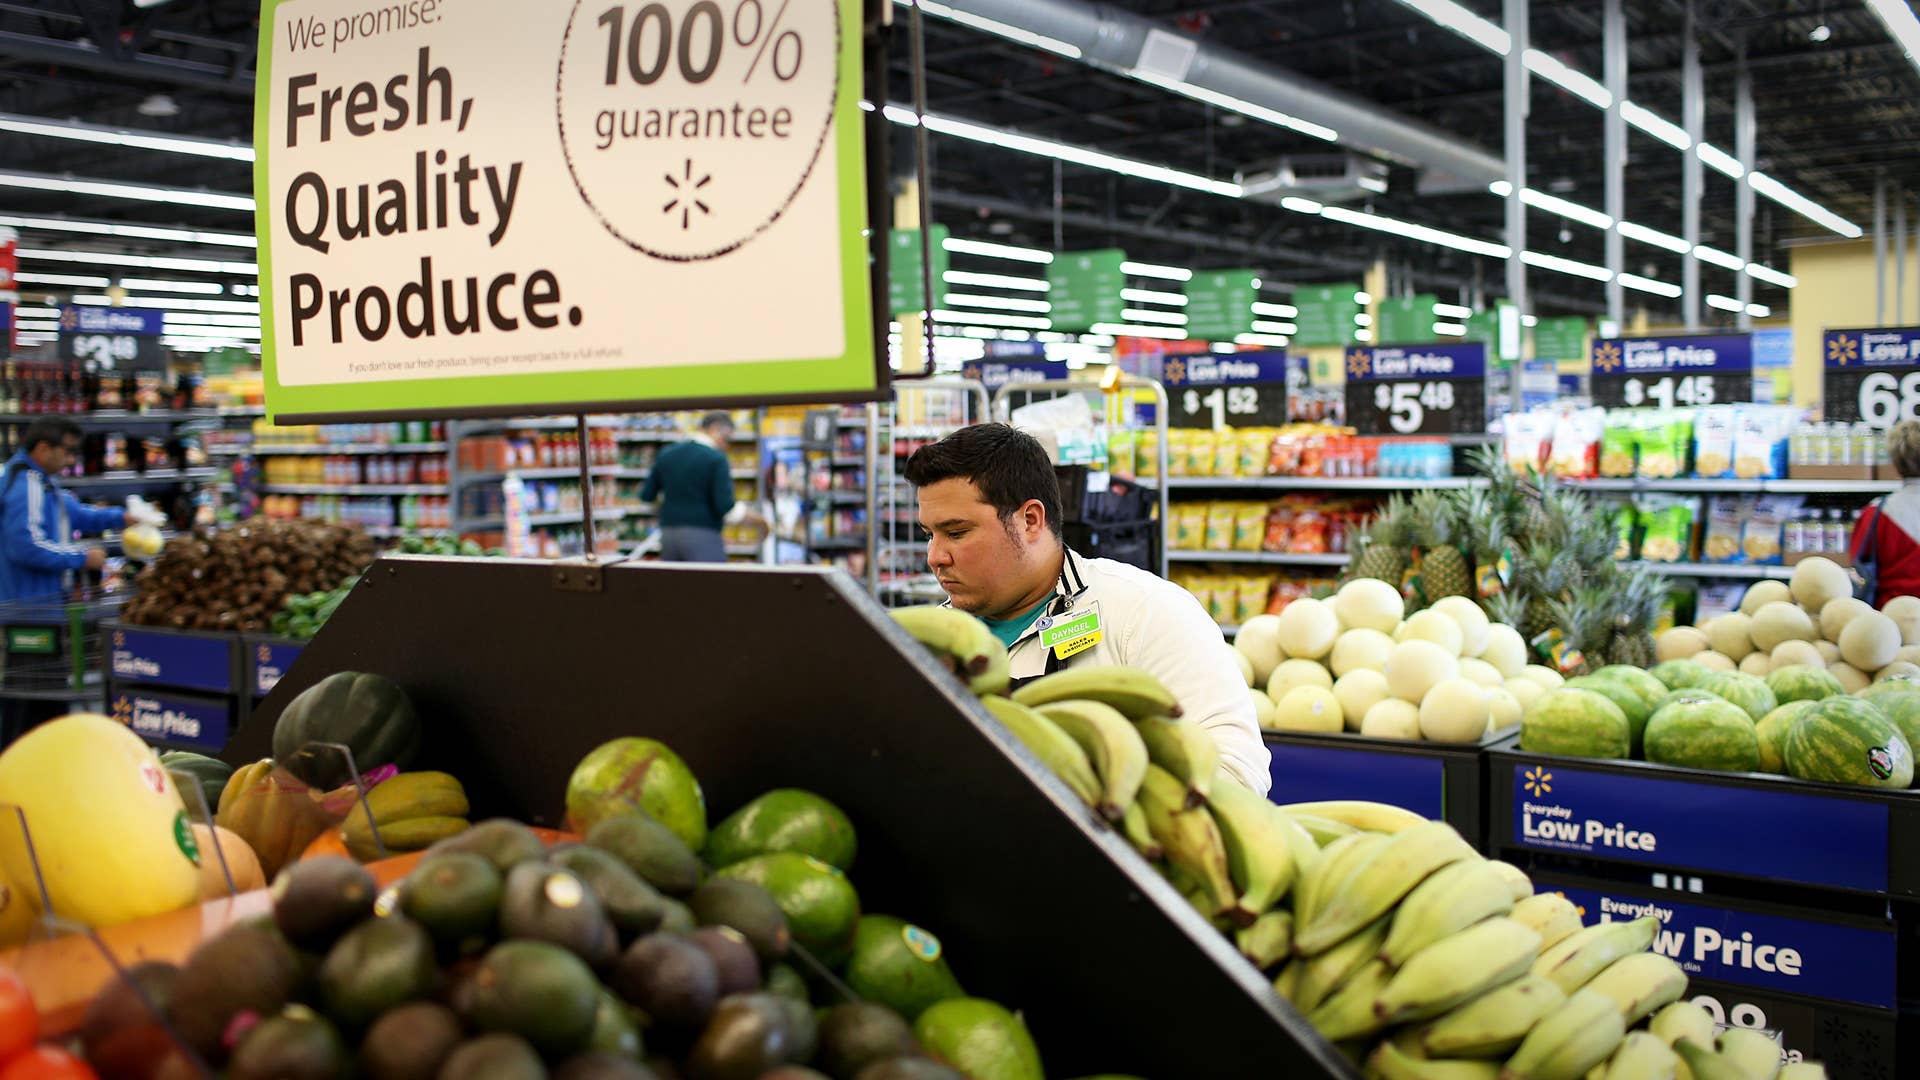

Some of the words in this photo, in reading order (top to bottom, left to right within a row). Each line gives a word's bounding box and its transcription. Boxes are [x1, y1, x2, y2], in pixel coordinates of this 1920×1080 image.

[288, 16, 326, 52] We
[333, 0, 442, 53] promise:
[598, 0, 802, 86] 100%
[286, 46, 475, 148] Fresh,
[596, 102, 792, 150] guarantee
[285, 149, 524, 254] Quality
[289, 257, 583, 346] Produce.
[1187, 363, 1219, 381] Low
[1220, 360, 1259, 380] Price
[1373, 356, 1408, 375] Low
[1410, 353, 1454, 373] Price
[1624, 349, 1664, 368] Low
[1666, 345, 1716, 366] Price
[1862, 342, 1908, 360] Low
[133, 709, 162, 731] Low
[163, 710, 200, 738] Price
[1523, 802, 1572, 819] Everyday
[1523, 812, 1580, 842] Low
[1585, 819, 1656, 851] Price
[1601, 897, 1673, 924] Everyday
[1694, 926, 1802, 976] Price
